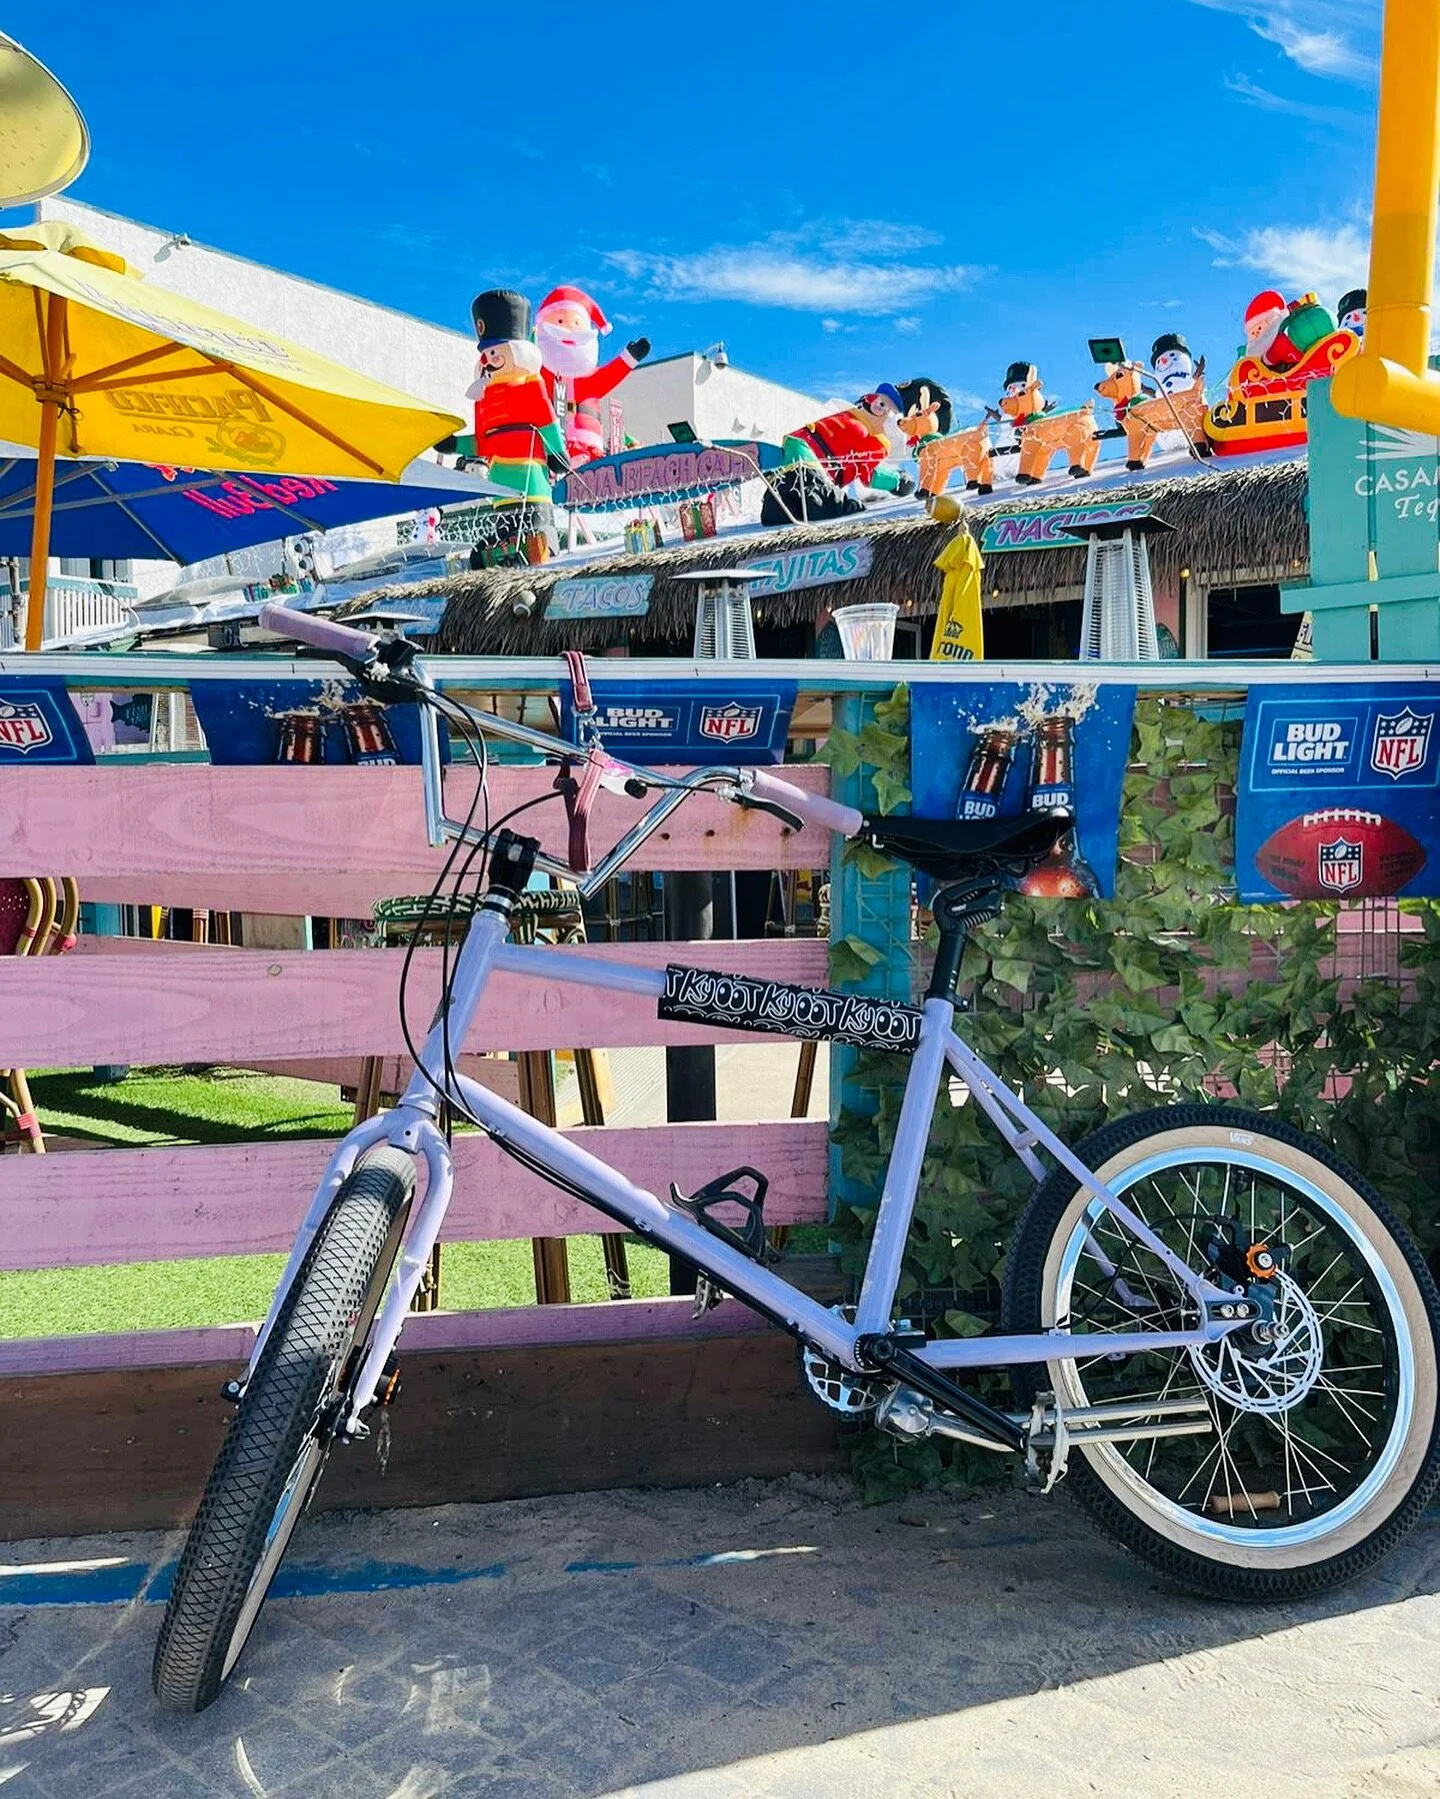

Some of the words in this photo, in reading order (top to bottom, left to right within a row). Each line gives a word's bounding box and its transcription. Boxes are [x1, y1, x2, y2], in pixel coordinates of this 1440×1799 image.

[560, 579, 646, 612] TACOS
[607, 707, 664, 718] BUD
[0, 720, 45, 744] NFL
[596, 717, 674, 728] LIGHT
[707, 719, 750, 736] NFL
[1287, 723, 1342, 742] BUD
[1273, 741, 1349, 761] LIGHT
[1377, 738, 1420, 769] NFL
[964, 800, 996, 818] BUD
[1032, 792, 1069, 808] BUD
[1324, 862, 1357, 886] NFL
